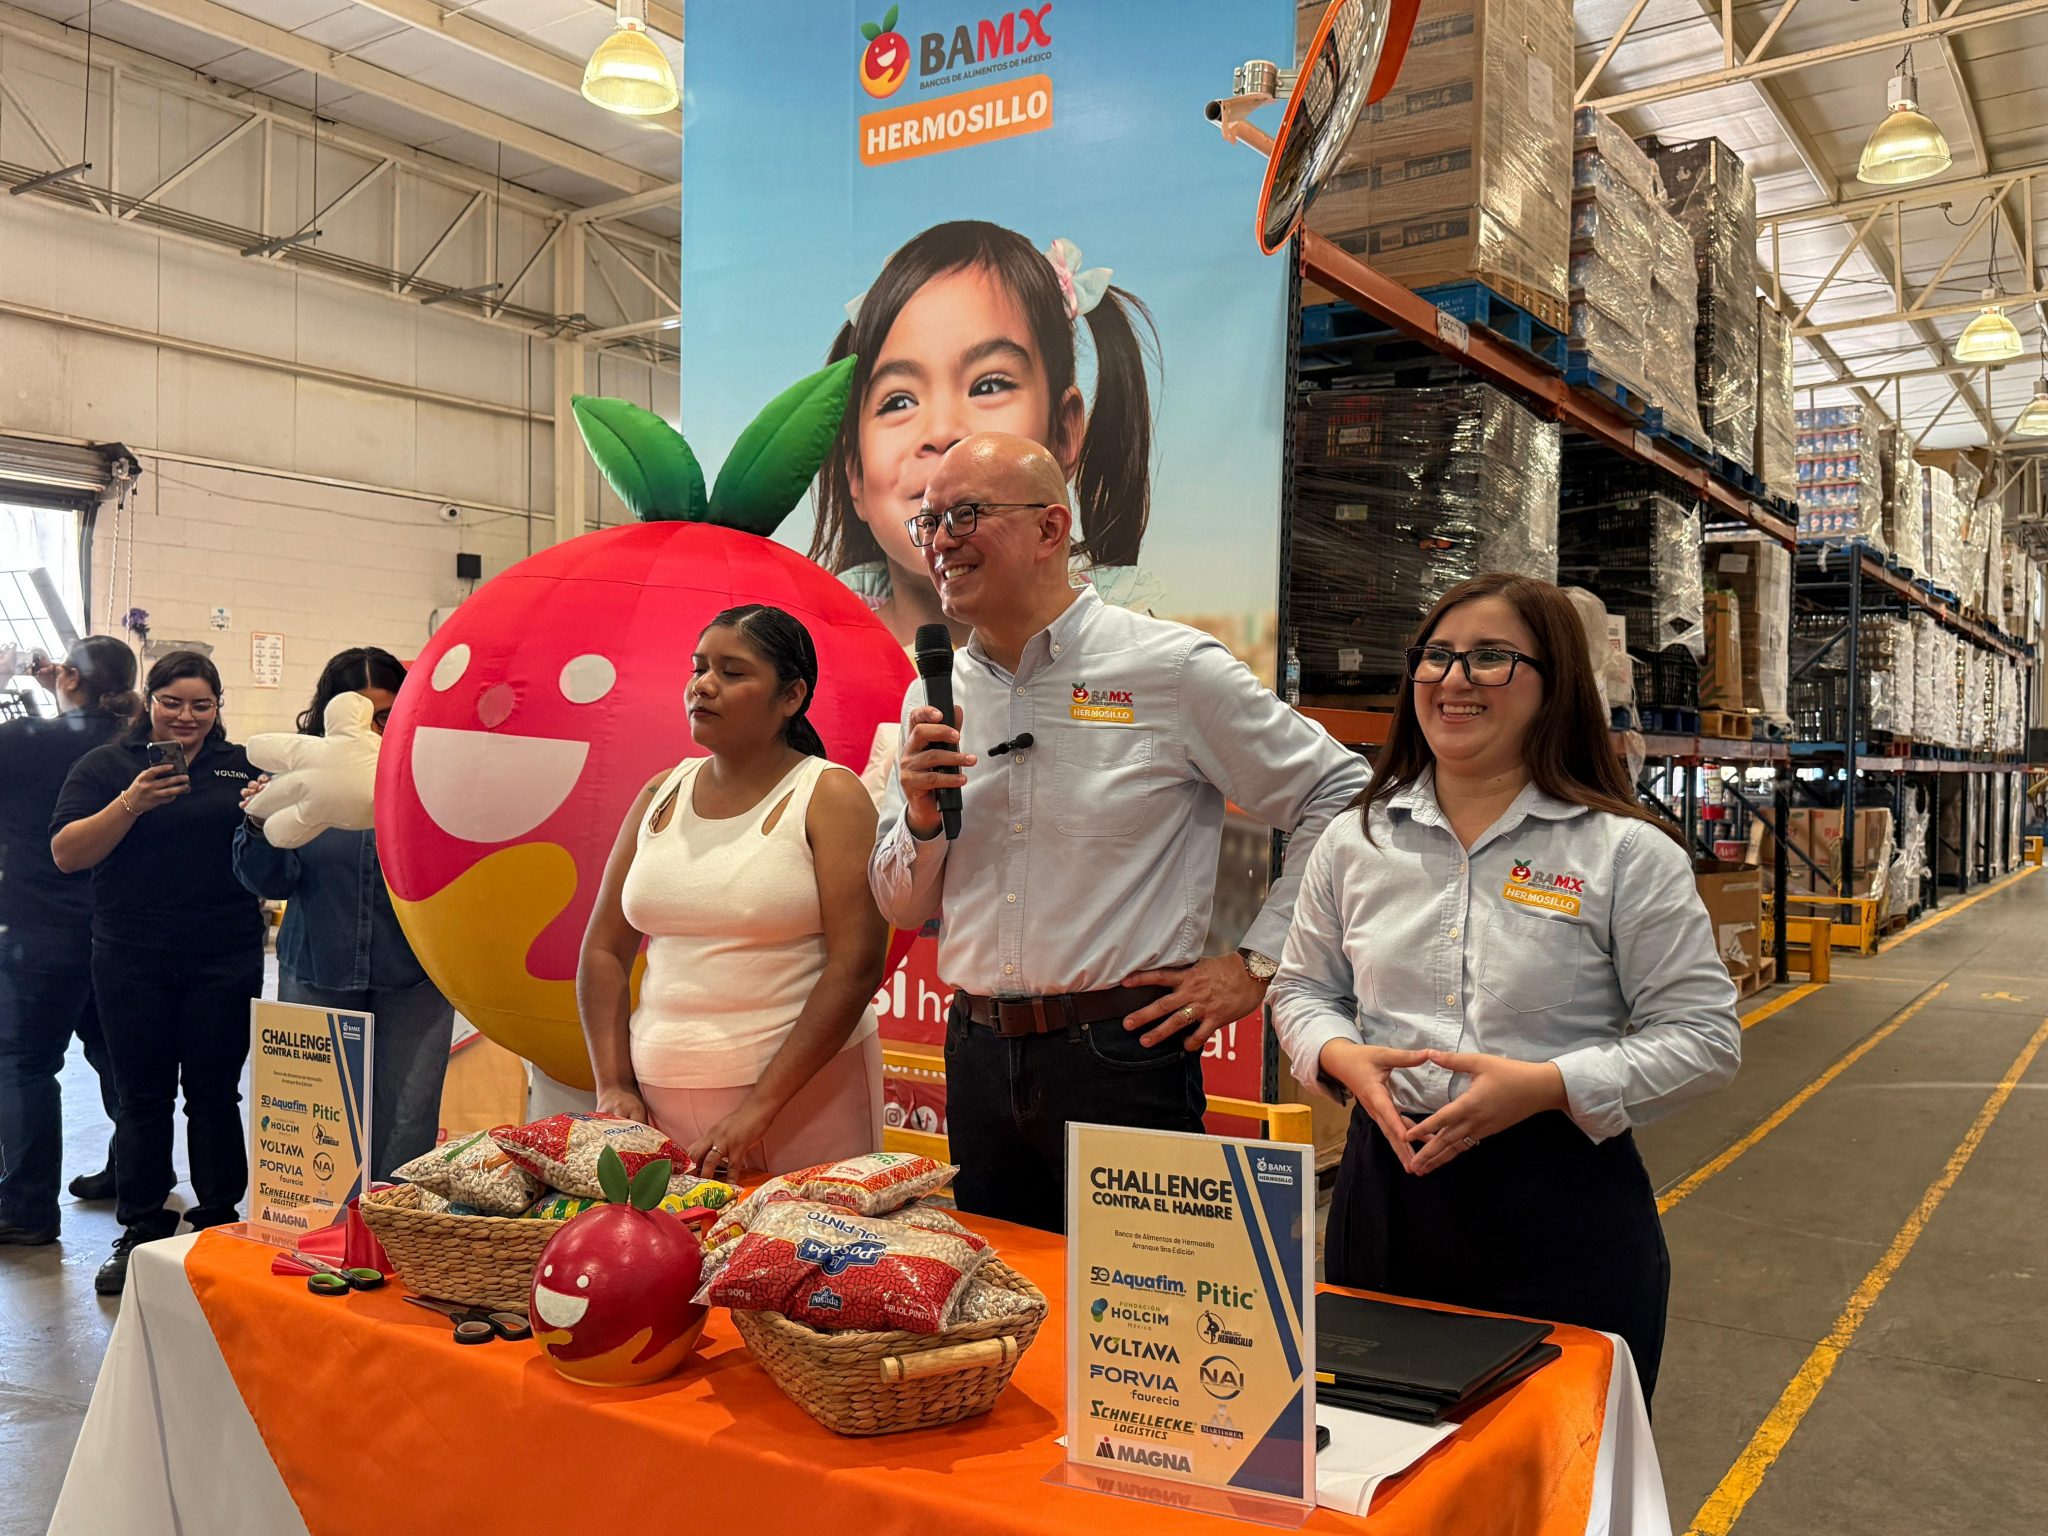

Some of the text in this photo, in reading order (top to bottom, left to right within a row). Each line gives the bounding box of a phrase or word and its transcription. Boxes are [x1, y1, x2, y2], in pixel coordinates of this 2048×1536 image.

[920, 3, 1052, 76] BAMX
[920, 51, 1052, 90] BANCOS DE ALIMENTOS DE MÉXICO
[866, 90, 1048, 155] HERMOSILLO
[1090, 690, 1133, 704] BAMX
[1073, 708, 1130, 720] HERMOSILLO
[1532, 870, 1584, 892] BAMX
[1506, 888, 1575, 910] HERMOSILLO
[262, 1028, 332, 1052] CHALLENGE
[262, 1045, 332, 1064] CONTRA EL HAMBRE
[312, 1102, 340, 1122] Pitic
[270, 1122, 300, 1134] HOLCIM
[260, 1138, 304, 1158] VOLTAVA
[260, 1158, 304, 1177] FORVIA
[313, 1160, 334, 1173] NAI
[1268, 1163, 1292, 1172] BAMX
[1090, 1166, 1232, 1203] CHALLENGE
[1260, 1175, 1292, 1184] HERMOSILLO
[260, 1182, 310, 1204] SCHNELLECKE
[1092, 1192, 1232, 1220] CONTRA EL HAMBRE
[272, 1212, 308, 1229] MAGNA
[807, 1211, 855, 1234] PINTO
[1114, 1230, 1133, 1238] Banco
[1142, 1234, 1172, 1243] Alimentos
[1182, 1238, 1215, 1249] Hermosillo
[1132, 1242, 1159, 1252] Arranque
[1172, 1247, 1195, 1256] Edición
[808, 1243, 885, 1259] Posada
[812, 1295, 838, 1307] Posada
[1197, 1280, 1253, 1310] Pitic
[884, 1304, 931, 1320] FRIJOL PINTO
[1120, 1301, 1160, 1312] FUNDACIÓN
[1111, 1307, 1169, 1326] HOLCIM
[1090, 1333, 1180, 1364] VOLTAVA
[1218, 1334, 1253, 1347] HERMOSILLO
[1090, 1364, 1179, 1393] FORVIA
[1200, 1366, 1244, 1387] NAI
[1132, 1389, 1180, 1406] faurecia
[1090, 1400, 1194, 1433] SCHNELLECKE
[1113, 1423, 1168, 1440] LOGISTICS
[1202, 1425, 1242, 1439] MARTINREA
[1117, 1445, 1192, 1473] MAGNA
